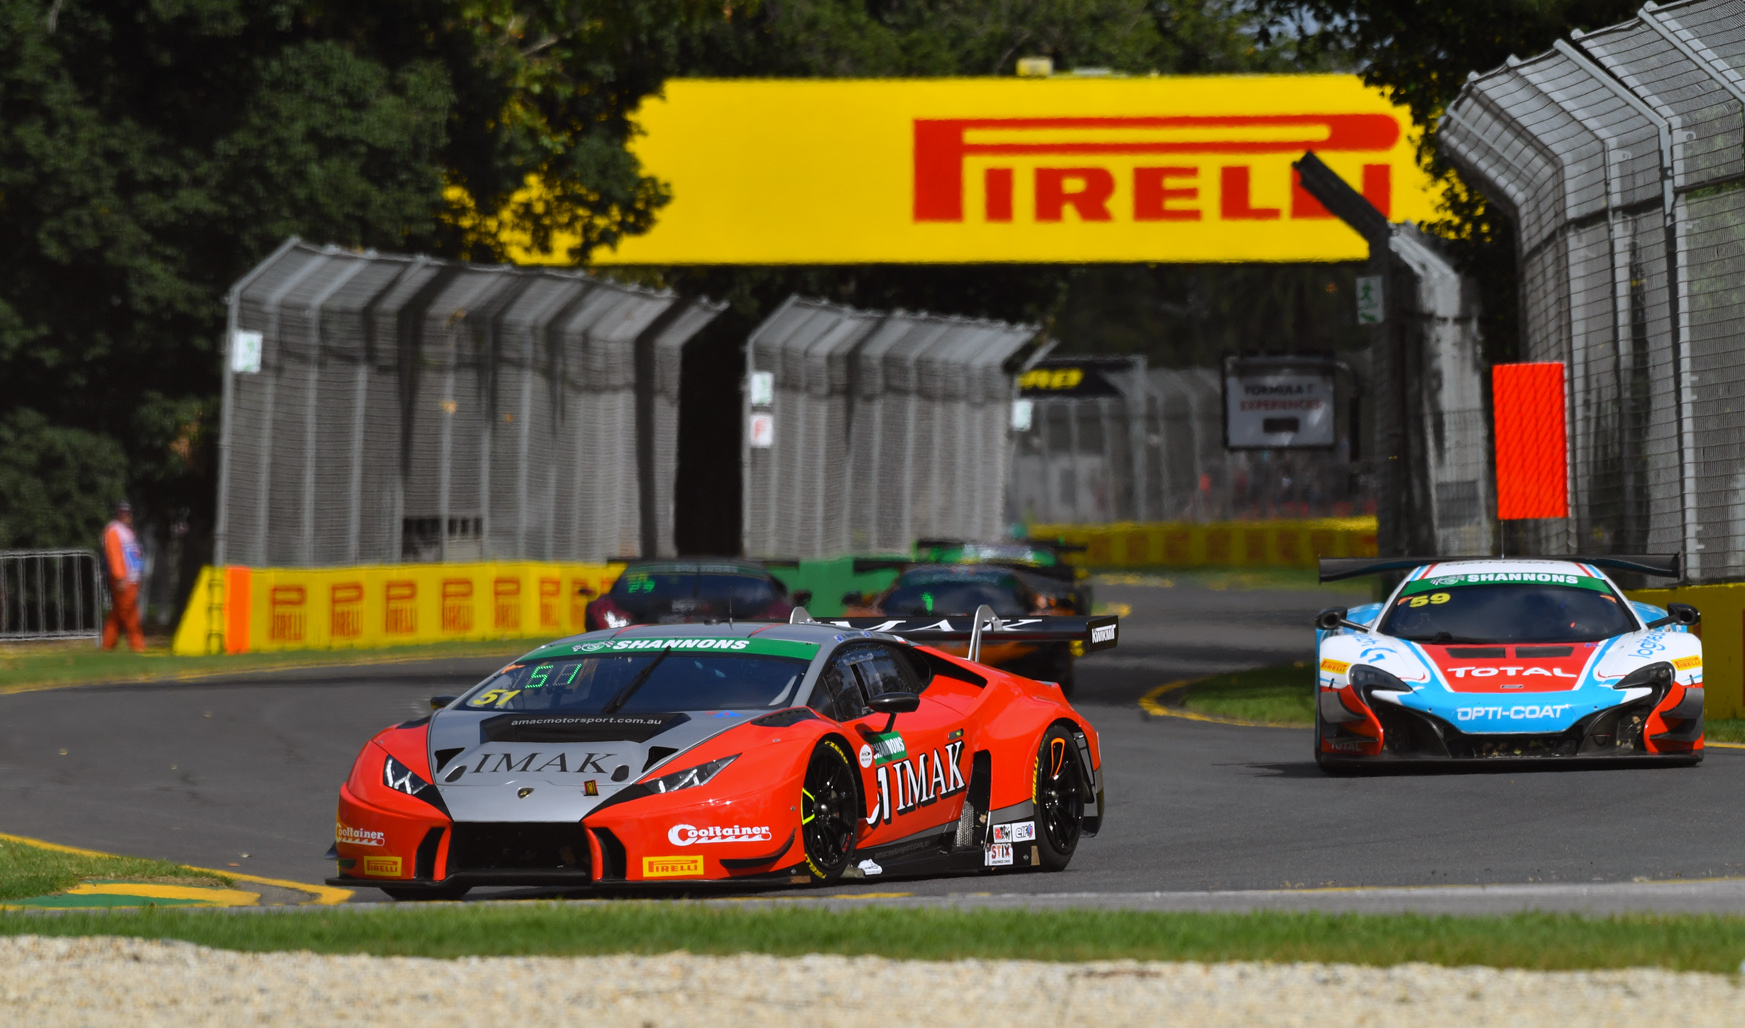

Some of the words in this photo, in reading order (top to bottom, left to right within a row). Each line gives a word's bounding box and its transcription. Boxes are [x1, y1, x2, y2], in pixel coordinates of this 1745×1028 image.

[913, 114, 1400, 223] PIRELLI
[1467, 573, 1579, 584] SHANNONS
[1409, 593, 1451, 607] 59
[612, 639, 750, 650] SHANNONS
[1321, 660, 1347, 672] PIRELLI
[1675, 657, 1700, 669] PIRELLI
[525, 663, 582, 688] 51
[1447, 666, 1577, 677] TOTAL
[473, 689, 521, 706] 51
[1457, 704, 1569, 720] OPTI-COAT
[511, 717, 662, 726] amacmotorsport.com.au
[469, 752, 618, 774] IMAK
[893, 741, 966, 811] IMAK
[336, 822, 385, 845] ooltainer
[668, 824, 770, 846] Cooltainer
[366, 860, 398, 873] PIRELLI
[648, 860, 698, 873] PIRELLI
